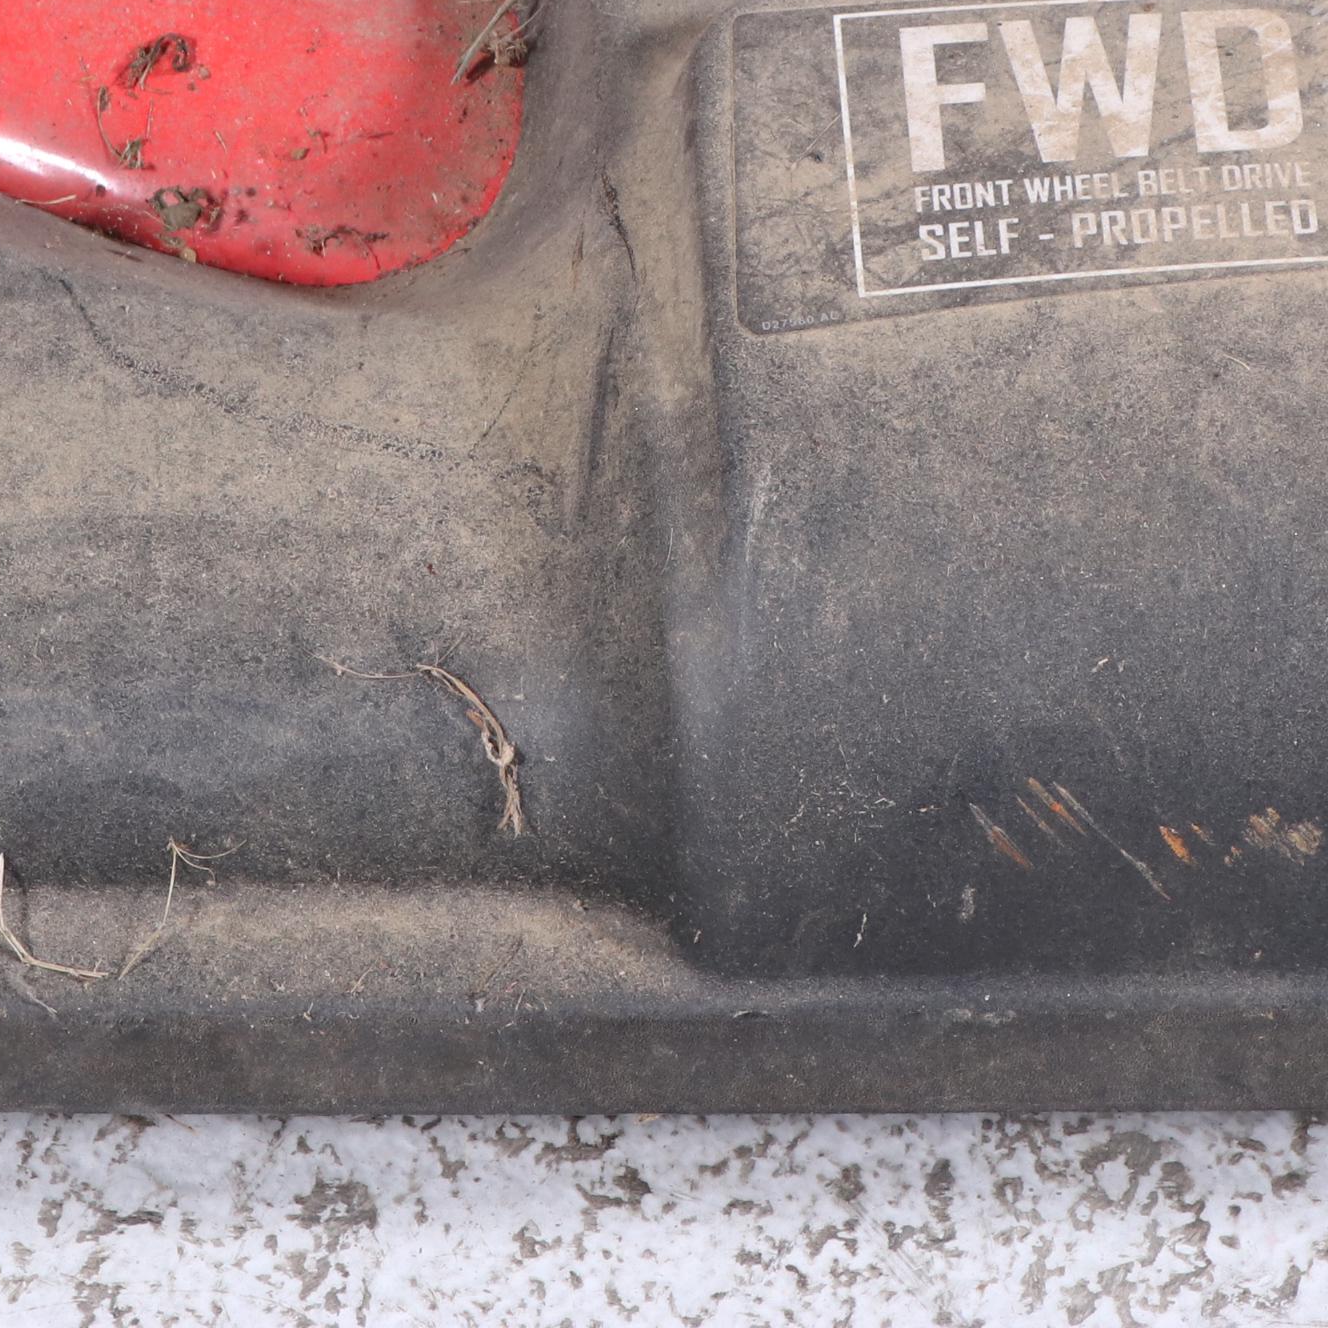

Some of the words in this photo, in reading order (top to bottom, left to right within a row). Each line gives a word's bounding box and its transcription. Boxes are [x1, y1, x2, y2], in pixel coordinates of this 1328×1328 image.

[898, 7, 1305, 173] FWD
[913, 179, 1014, 213] FRONT
[1024, 171, 1129, 205] WHEEL
[1137, 165, 1212, 197] BELT
[1221, 161, 1313, 191] DRIVE
[919, 217, 1021, 262] SELF
[1072, 198, 1319, 250] PROPELLED
